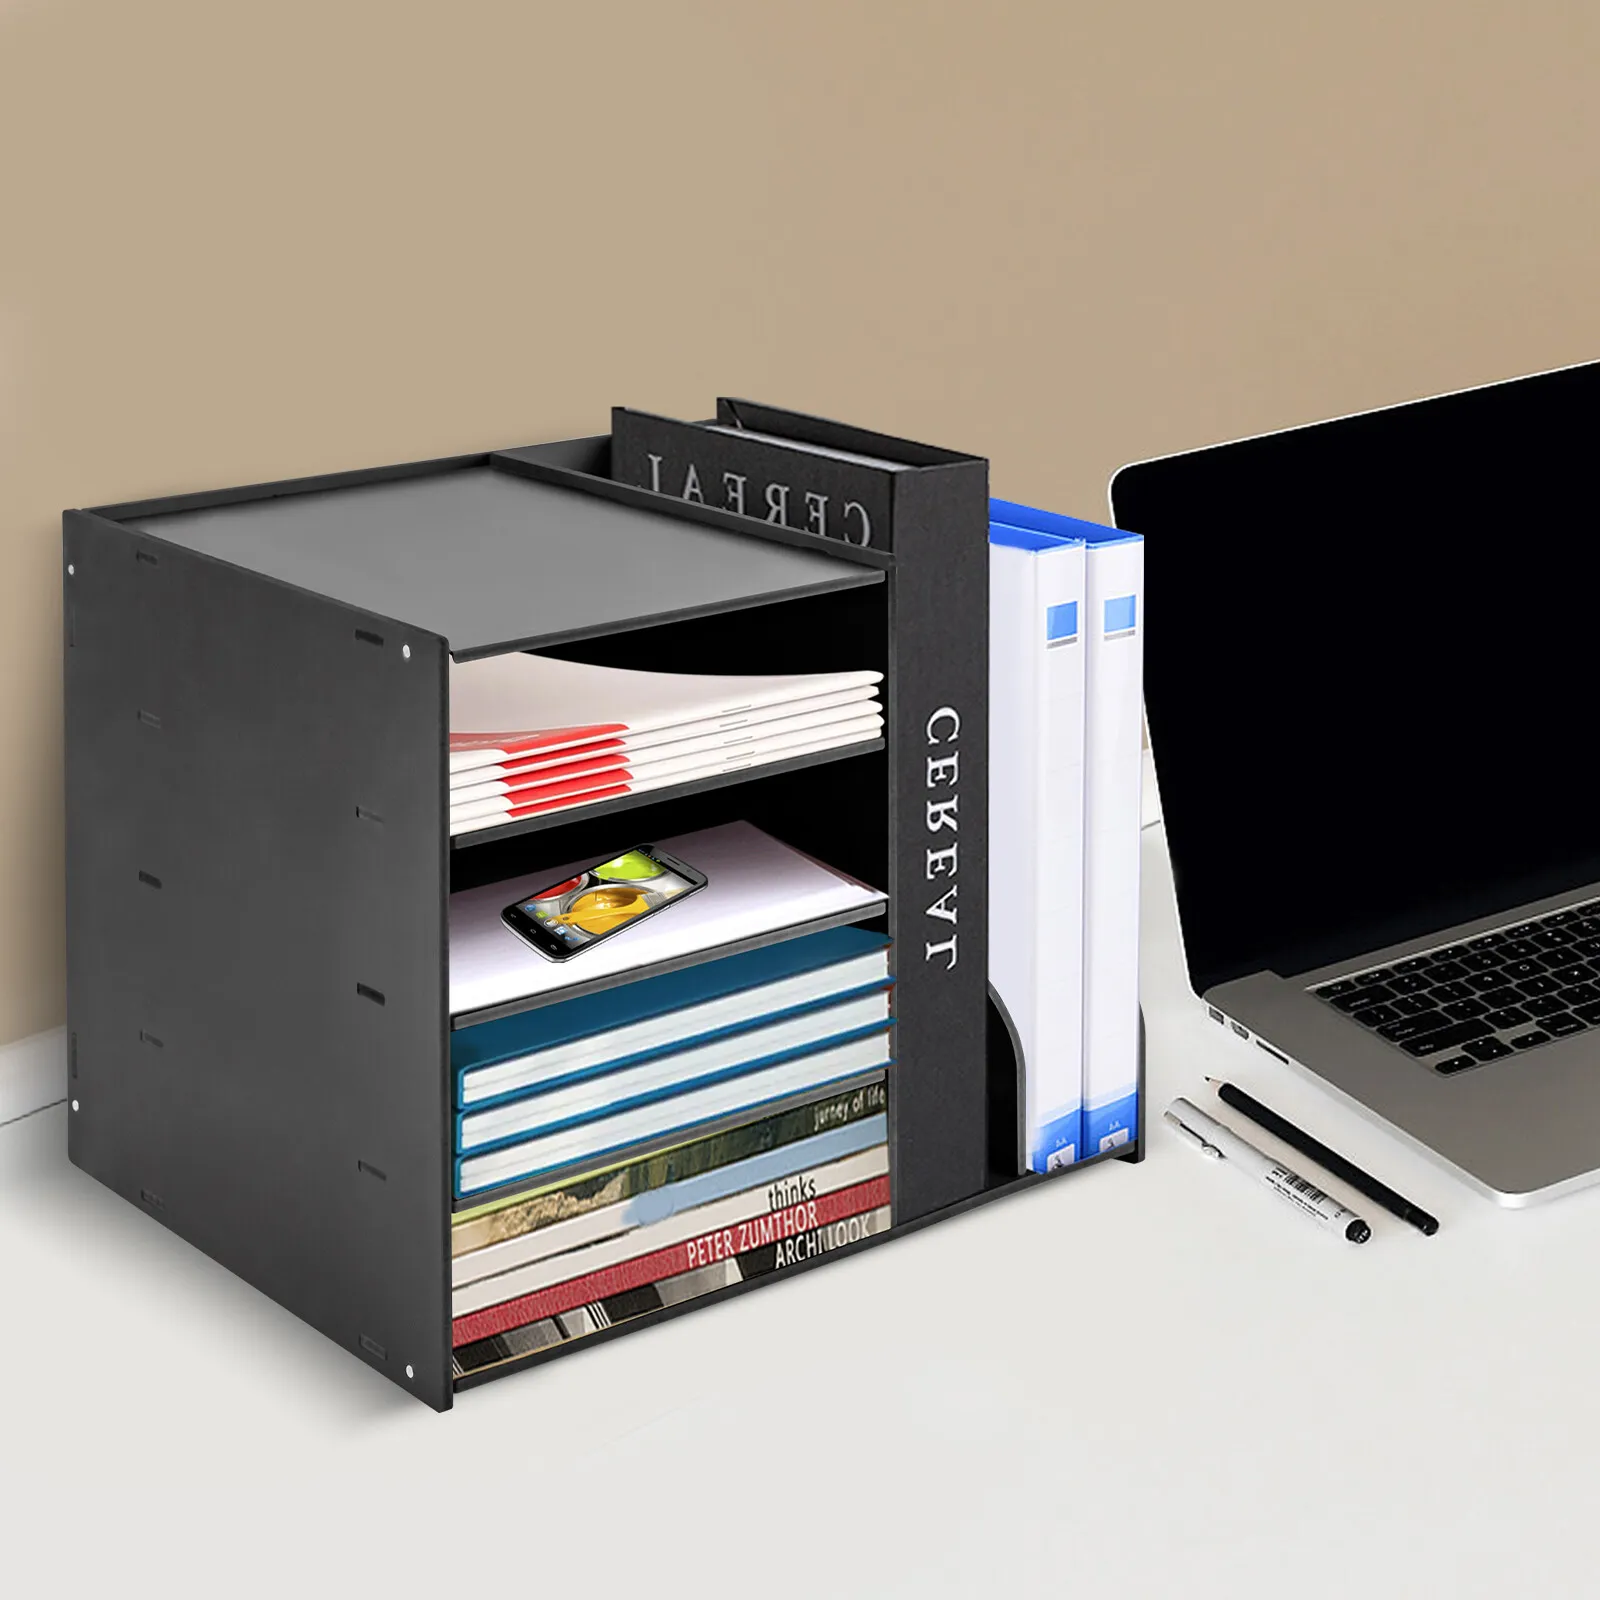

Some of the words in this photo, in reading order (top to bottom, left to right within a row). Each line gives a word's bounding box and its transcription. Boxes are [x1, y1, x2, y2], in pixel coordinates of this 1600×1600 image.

[852, 1088, 865, 1113] of
[768, 1175, 816, 1212] thinks
[686, 1230, 734, 1268] PETER
[738, 1201, 819, 1251] ZUMTHOR
